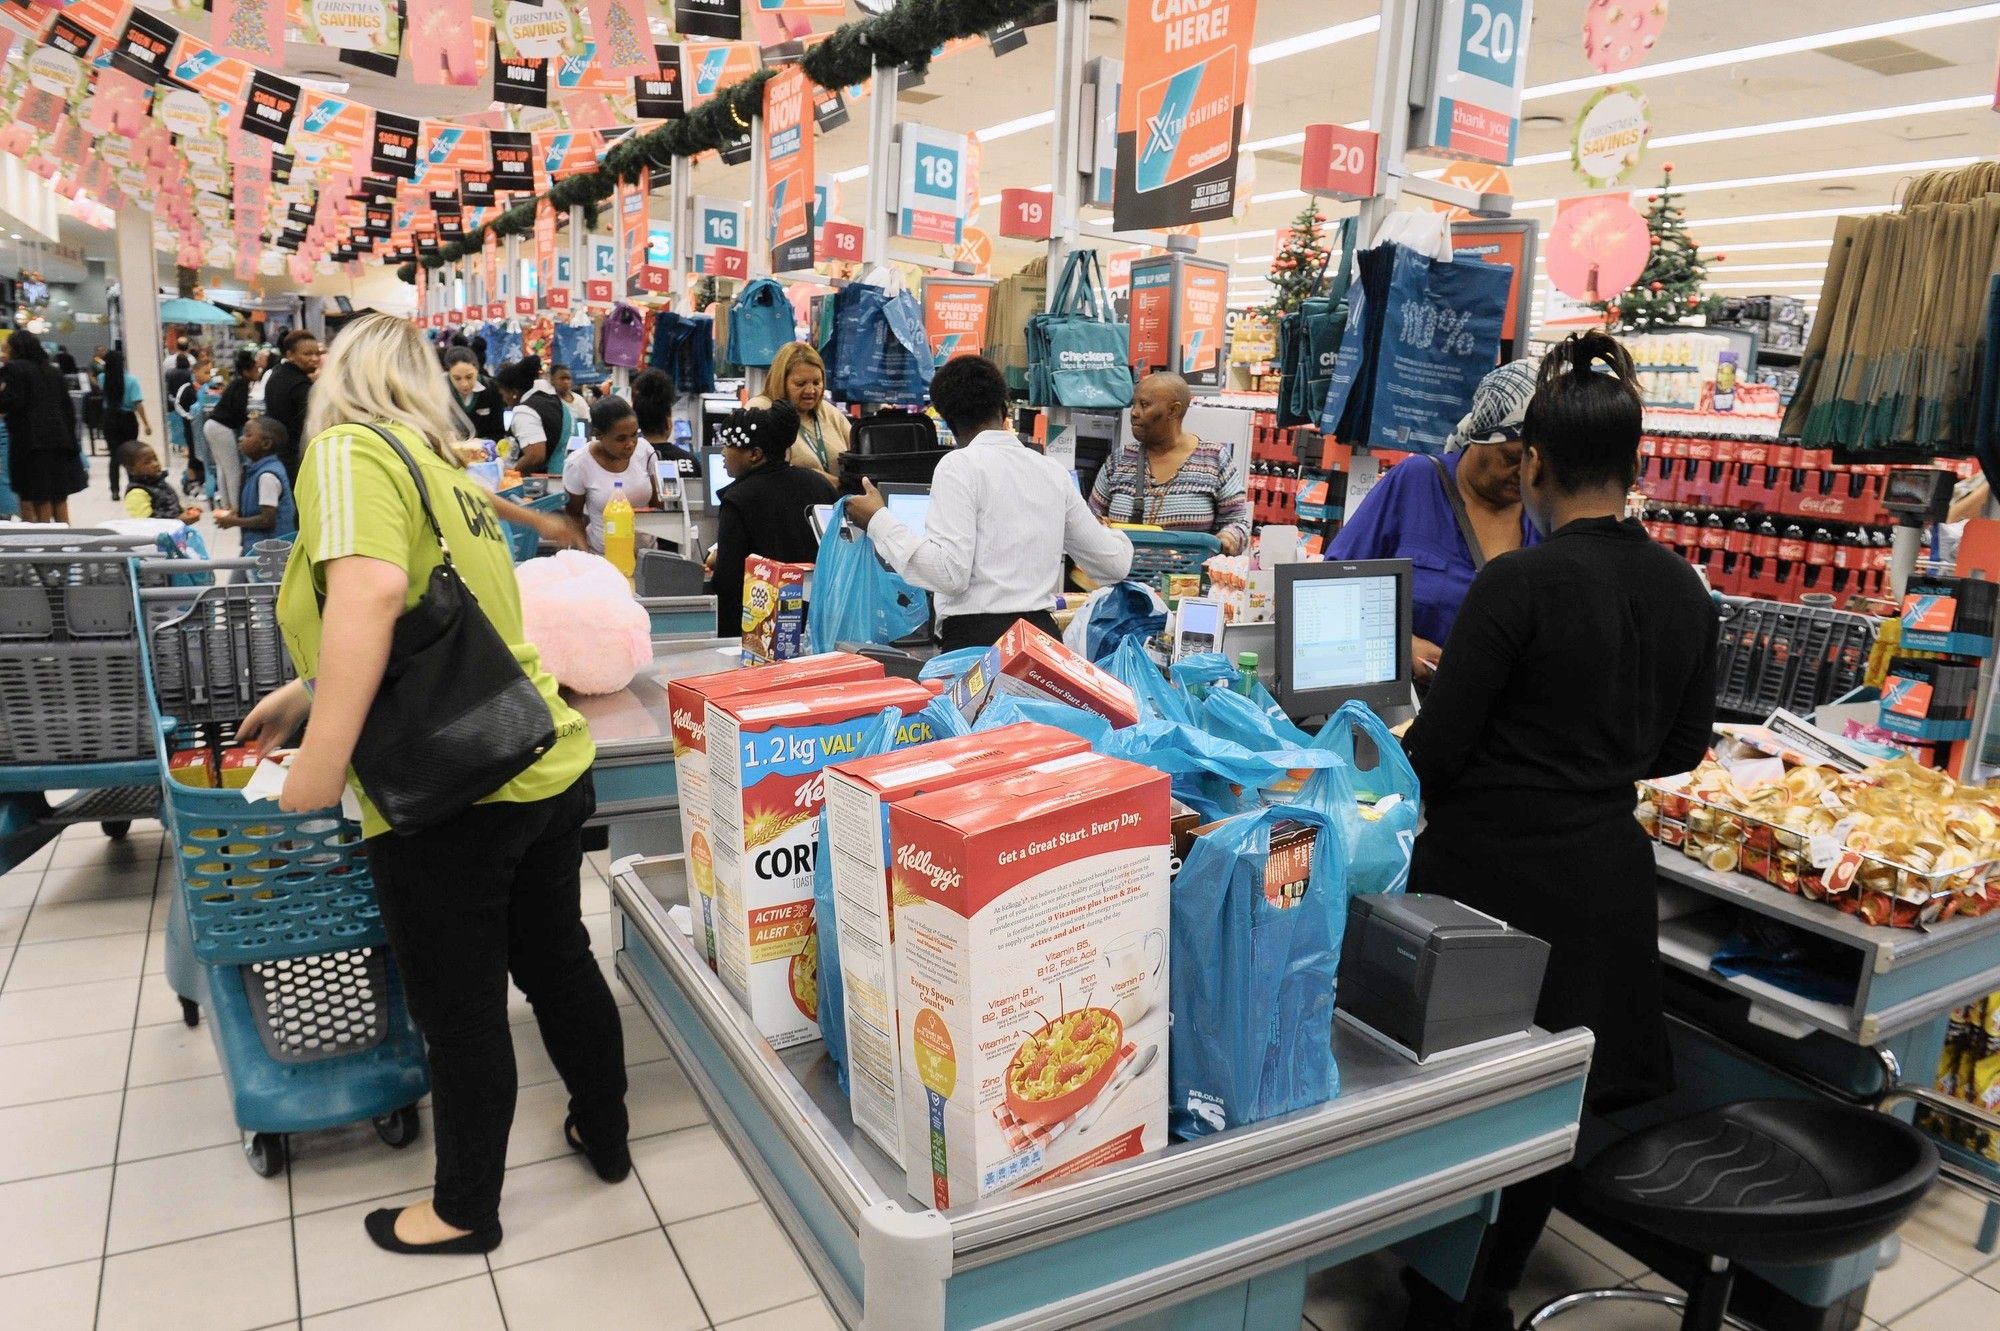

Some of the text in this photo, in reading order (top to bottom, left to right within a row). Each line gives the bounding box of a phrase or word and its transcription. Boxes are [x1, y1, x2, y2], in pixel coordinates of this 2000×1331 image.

[317, 1, 380, 13] CHRISTMAS
[1151, 0, 1203, 23] CA
[319, 12, 381, 29] SAVINGS
[509, 11, 564, 26] CHRISTMAS
[512, 20, 567, 41] SAVINGS
[1165, 5, 1230, 53] HERE!
[1467, 3, 1515, 64] 20
[507, 66, 536, 82] NOW!
[646, 81, 672, 95] NOW!
[770, 93, 803, 134] NOW
[1189, 95, 1230, 128] SAVINGS
[1453, 107, 1509, 138] thank you
[1583, 127, 1640, 157] SAVINGS
[1329, 143, 1365, 175] 20
[920, 155, 954, 189] 18
[913, 212, 956, 231] thank you
[1018, 202, 1043, 224] 19
[708, 217, 734, 240] 16
[834, 232, 855, 251] 18
[725, 256, 742, 271] 17
[647, 271, 663, 286] 16
[552, 294, 565, 304] 14
[594, 286, 608, 296] 15
[934, 302, 984, 313] REWARDS
[938, 311, 979, 322] CARD IS
[944, 321, 974, 331] HERE!
[1060, 350, 1115, 362] Checkers
[1319, 352, 1338, 367] Ch
[1057, 436, 1073, 446] Gift
[1350, 484, 1370, 496] Card
[750, 585, 769, 602] COCO
[1028, 670, 1041, 681] Get
[1045, 680, 1064, 695] Great
[1062, 691, 1081, 706] Start.
[894, 721, 934, 746] ACK
[820, 733, 863, 756] VAL
[794, 772, 825, 808] Ke
[998, 812, 1142, 866] Get a Great Start. Every Day.
[897, 843, 963, 892] Kellogg's
[792, 876, 816, 889] TOAST
[754, 906, 793, 924] ACTIVE
[1012, 924, 1035, 937] fortified
[1048, 915, 1053, 923] 9
[1054, 904, 1087, 921] Vitamins
[1087, 899, 1102, 911] plus
[1103, 893, 1119, 904] Iron
[1119, 890, 1126, 898] &
[1127, 885, 1141, 895] Zinc
[755, 925, 790, 942] ALERT
[990, 921, 1012, 936] provide
[1030, 937, 1052, 949] active
[1053, 929, 1068, 941] and
[1068, 923, 1086, 935] alert
[1037, 963, 1058, 978] B12,
[1060, 956, 1079, 968] Folic
[1080, 947, 1097, 960] Acid
[1045, 946, 1075, 962] Vitamin
[1080, 973, 1096, 985] Iron
[1111, 971, 1146, 992] Vitamin D
[910, 974, 955, 1006] Every Spoon
[988, 986, 1038, 1010] Vitamin B1,
[919, 992, 945, 1012] Counts
[982, 1011, 999, 1024] B2,
[1020, 994, 1045, 1009] Niacin
[978, 1030, 1020, 1052] Vitamin A
[982, 1075, 1001, 1089] Zinc
